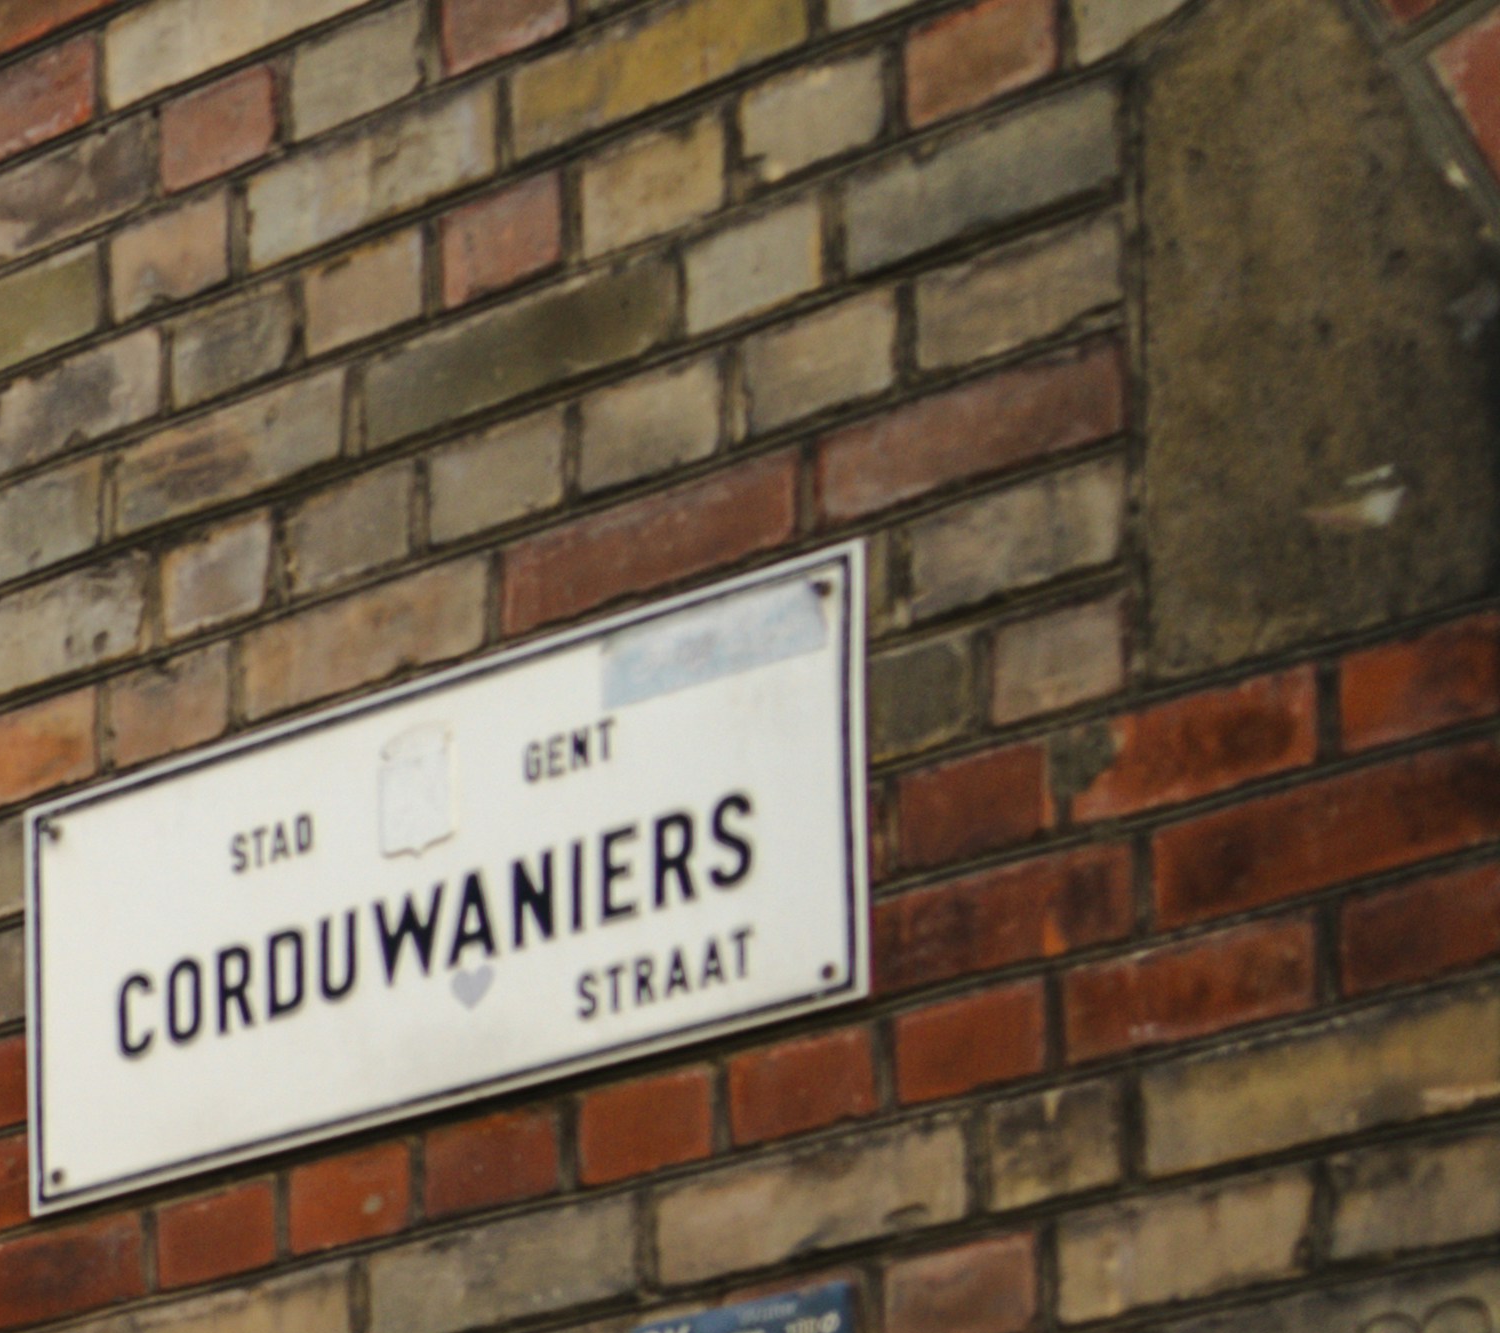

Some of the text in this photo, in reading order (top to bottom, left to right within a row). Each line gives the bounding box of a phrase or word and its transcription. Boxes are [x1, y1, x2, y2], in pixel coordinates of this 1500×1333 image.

[229, 718, 617, 874] STAD GENT
[116, 791, 755, 1060] CORDUWANIERS
[576, 928, 755, 1020] STRAAT
